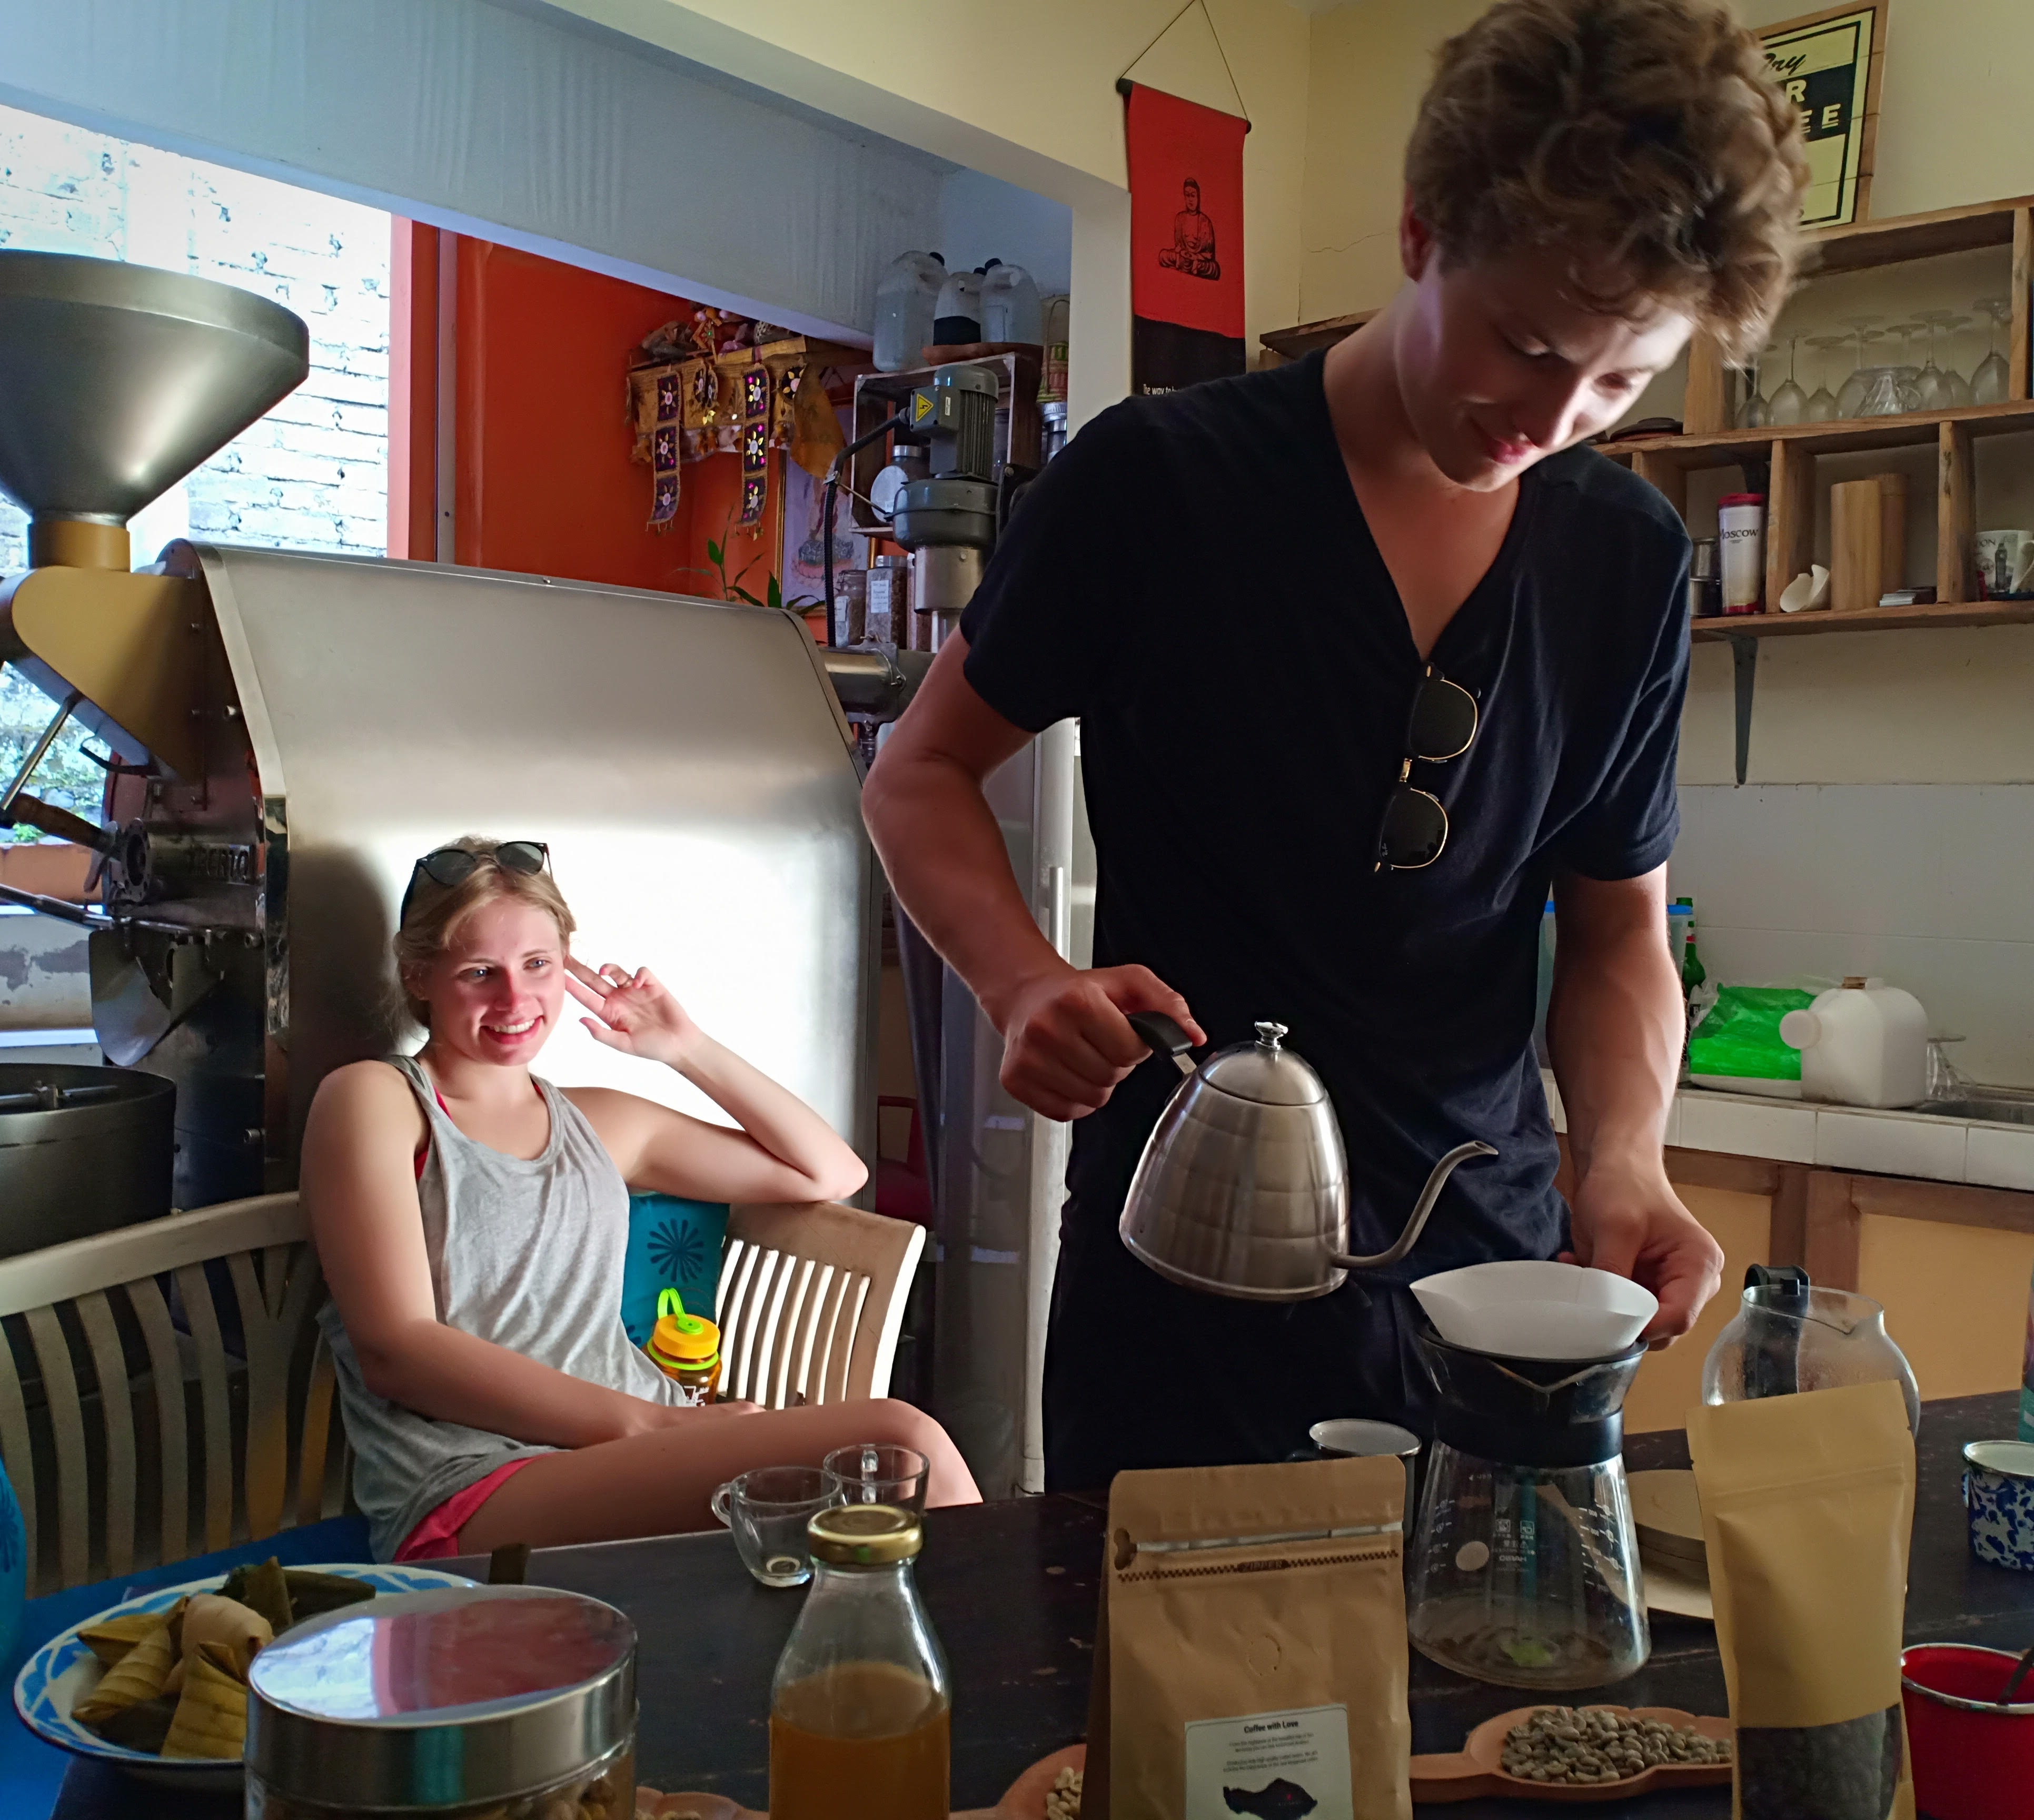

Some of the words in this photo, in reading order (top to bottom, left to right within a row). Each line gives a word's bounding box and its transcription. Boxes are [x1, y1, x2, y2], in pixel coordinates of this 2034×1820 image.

[1244, 1724, 1266, 1734] Coffee
[1267, 1721, 1281, 1730] with
[1283, 1720, 1299, 1729] Love
